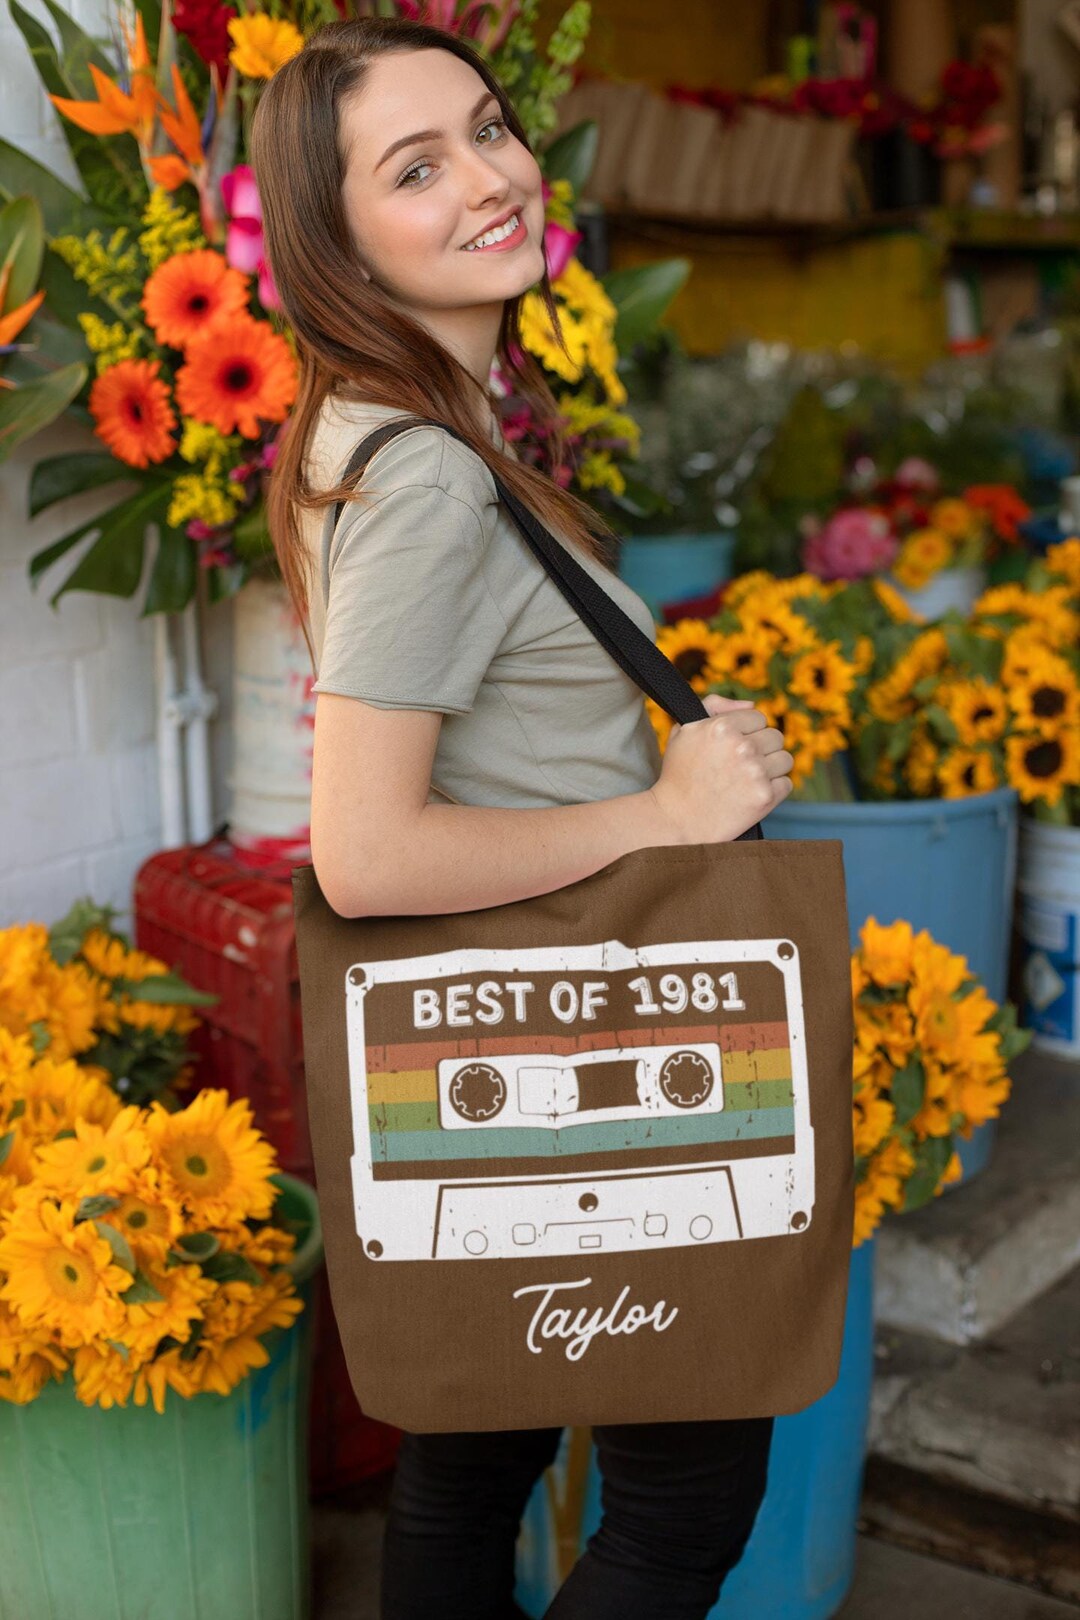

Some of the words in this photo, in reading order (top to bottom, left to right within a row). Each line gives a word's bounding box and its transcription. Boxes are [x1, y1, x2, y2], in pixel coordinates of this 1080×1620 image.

[413, 981, 535, 1030] BEST
[549, 981, 610, 1024] OF
[628, 972, 746, 1015] 1981
[513, 1277, 679, 1361] Taylor
